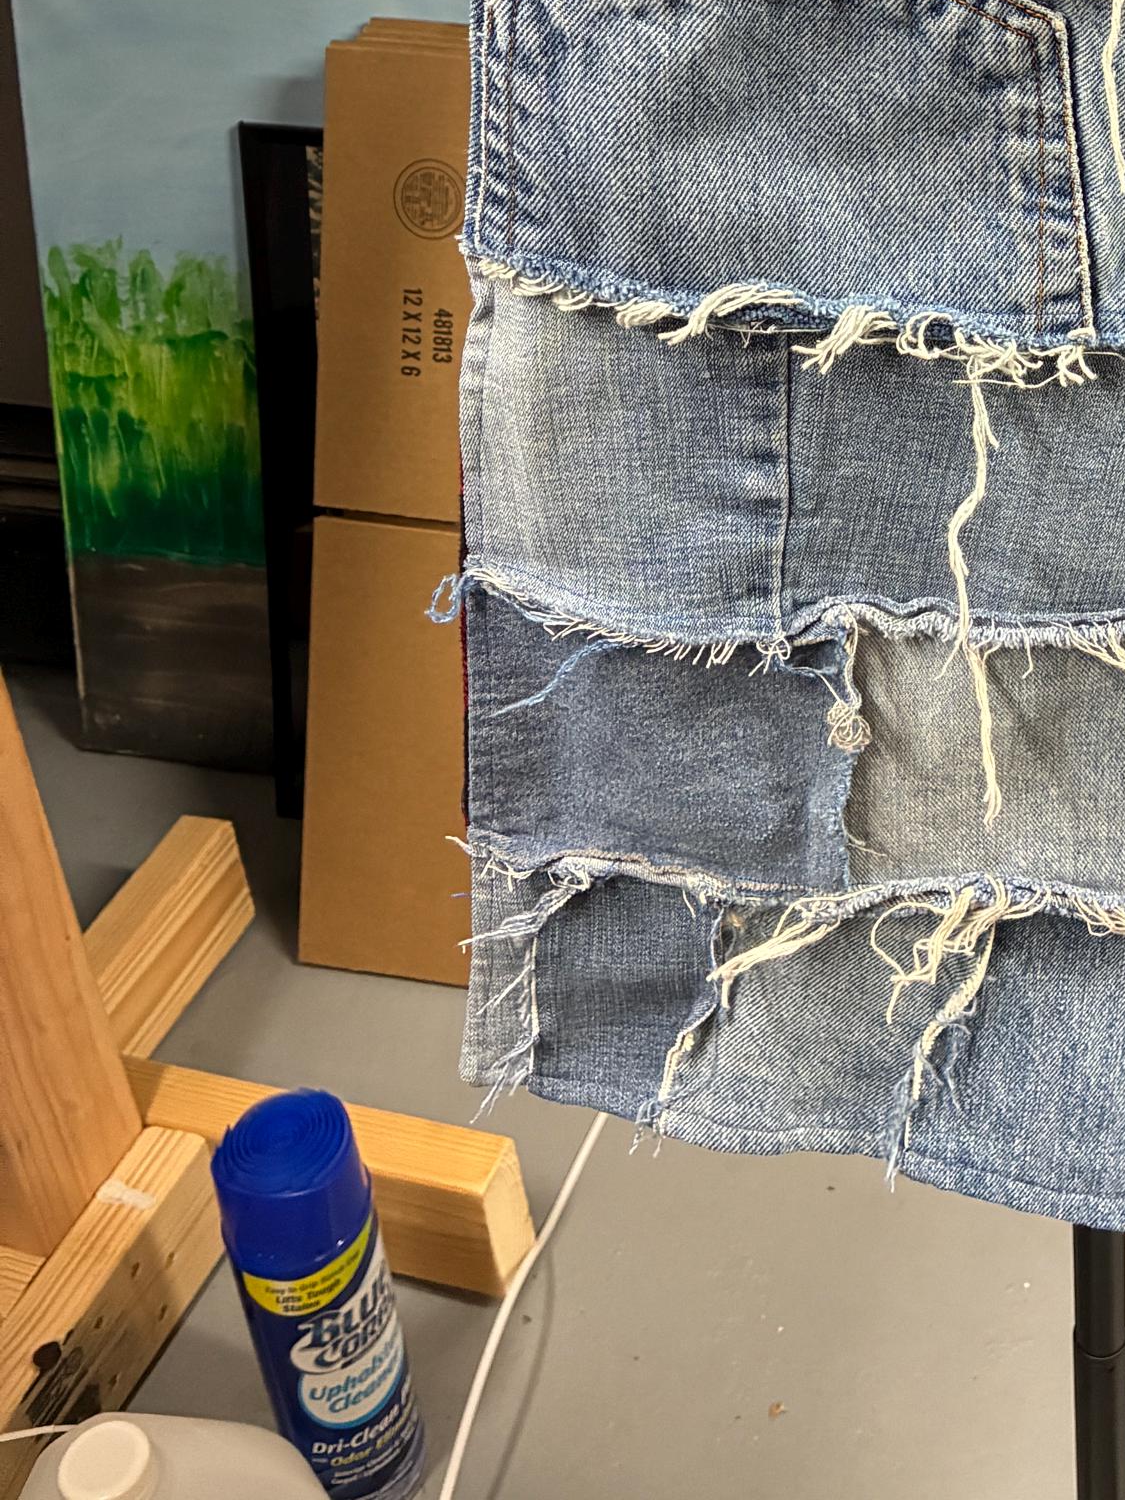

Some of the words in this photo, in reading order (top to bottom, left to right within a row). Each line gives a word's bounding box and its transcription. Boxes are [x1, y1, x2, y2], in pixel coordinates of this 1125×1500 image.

[403, 287, 423, 307] 12
[402, 311, 422, 322] X
[402, 326, 421, 345] 12
[432, 308, 453, 364] 481813
[401, 350, 421, 361] X
[401, 366, 421, 377] 6
[312, 1404, 399, 1454] Dri-Clean
